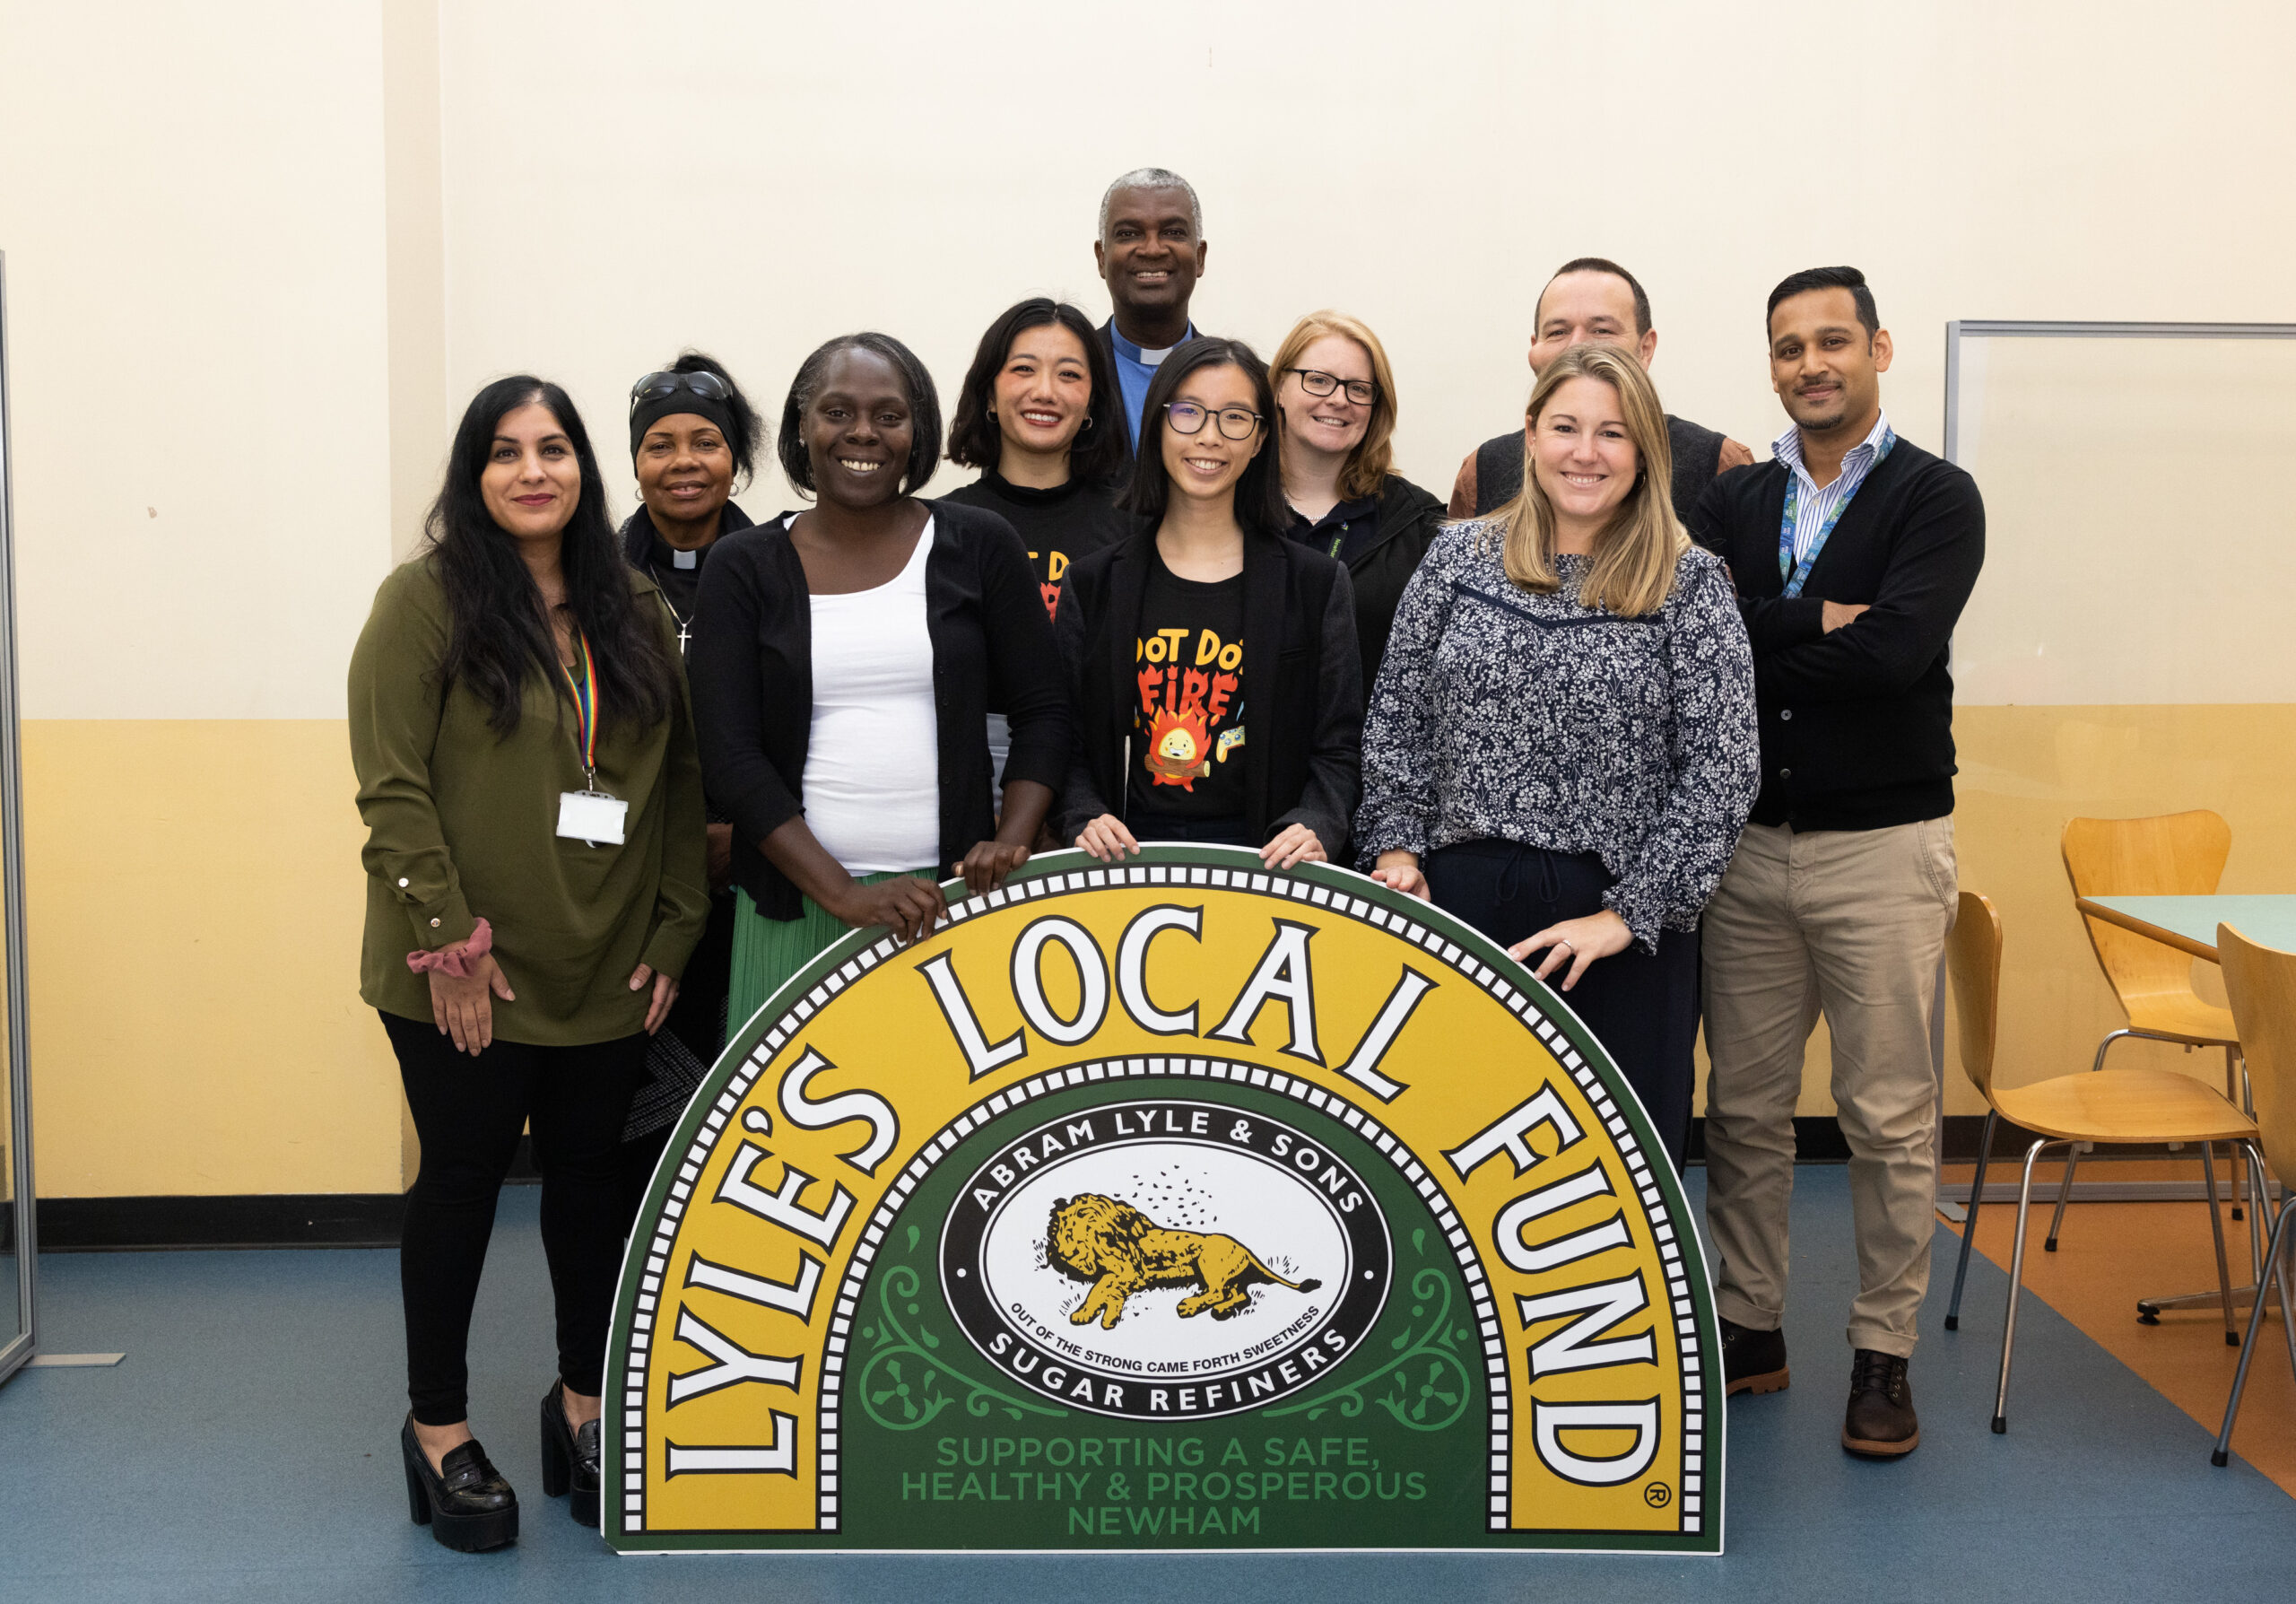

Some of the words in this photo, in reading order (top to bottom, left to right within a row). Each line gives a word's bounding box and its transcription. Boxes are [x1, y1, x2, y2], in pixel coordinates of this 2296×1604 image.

[665, 1043, 900, 1482] LYLE'S
[915, 903, 1440, 1105] LOCAL
[1439, 1077, 1661, 1487] FUND
[973, 1120, 1095, 1211] ABRAM
[1115, 1110, 1209, 1135] LYLE
[1230, 1120, 1253, 1144] &
[1271, 1134, 1363, 1212] SONS
[989, 1332, 1124, 1408] SUGAR
[1151, 1329, 1347, 1410] REFINERS
[1011, 1303, 1037, 1328] OUT
[1035, 1326, 1055, 1340] OF
[1056, 1337, 1083, 1356] THE
[1084, 1350, 1143, 1372] STRONG
[1147, 1361, 1189, 1373] CAME
[1193, 1352, 1240, 1371] FORTH
[1243, 1305, 1319, 1359] SWEETNESS
[902, 1472, 1091, 1501] HEALTHY
[1106, 1472, 1132, 1501] &
[1148, 1472, 1427, 1501] PROSPEROUS
[936, 1437, 1204, 1467] SUPPORTING
[1221, 1438, 1248, 1466] A
[1264, 1437, 1379, 1471] SAFE,
[1068, 1506, 1260, 1535] NEWHAM
